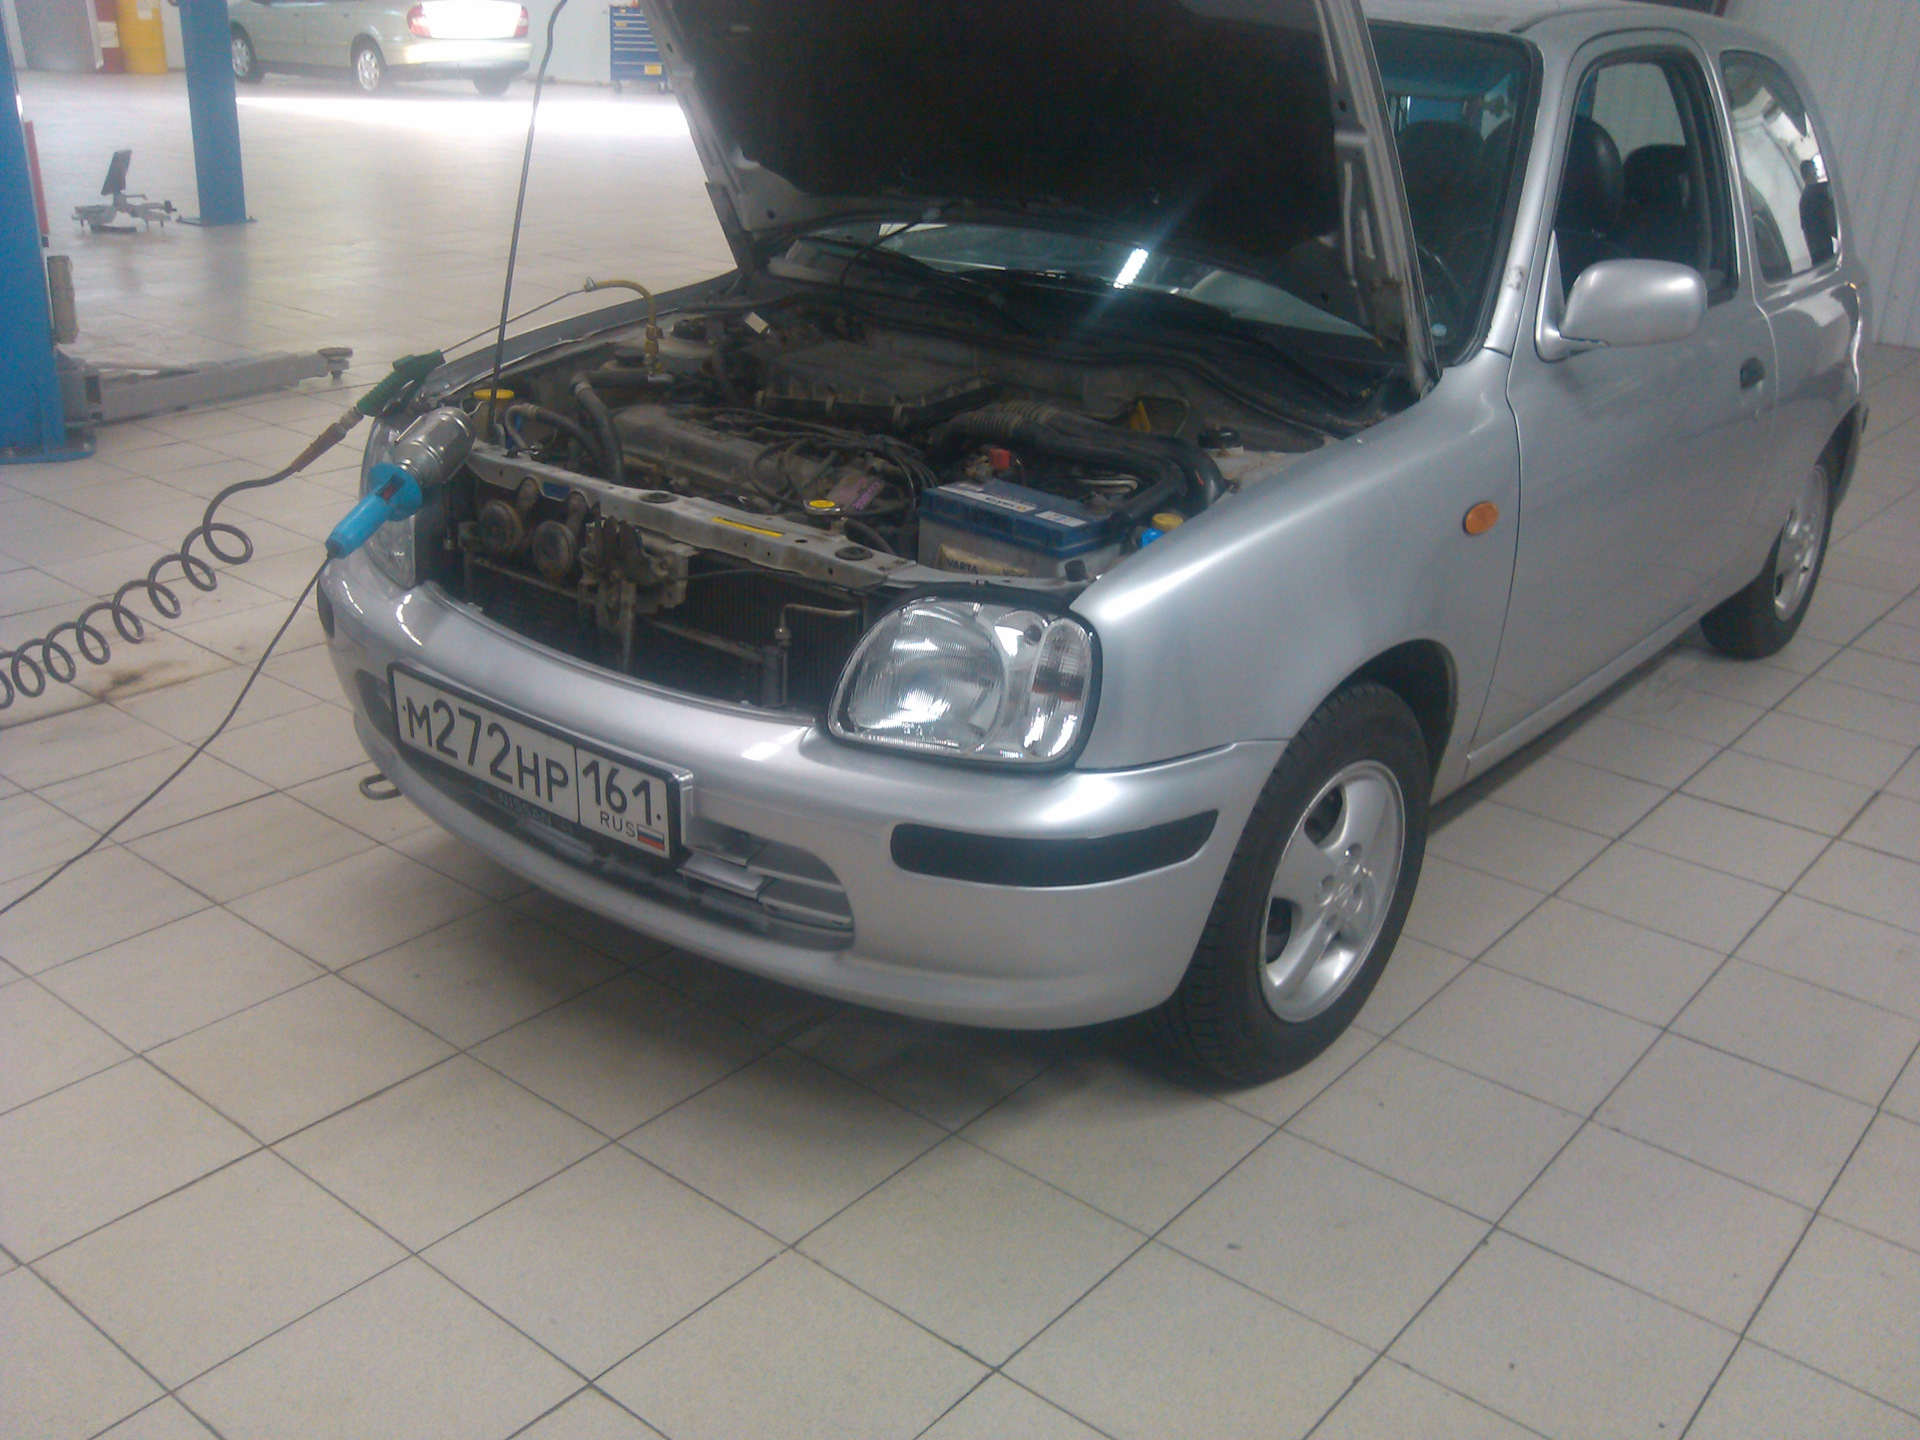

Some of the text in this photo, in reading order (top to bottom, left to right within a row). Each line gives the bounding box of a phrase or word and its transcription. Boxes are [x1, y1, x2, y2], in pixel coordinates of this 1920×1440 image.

[946, 559, 978, 574] VARTA
[582, 759, 652, 826] 161
[498, 793, 552, 826] NISSAN
[600, 811, 636, 838] RUS
